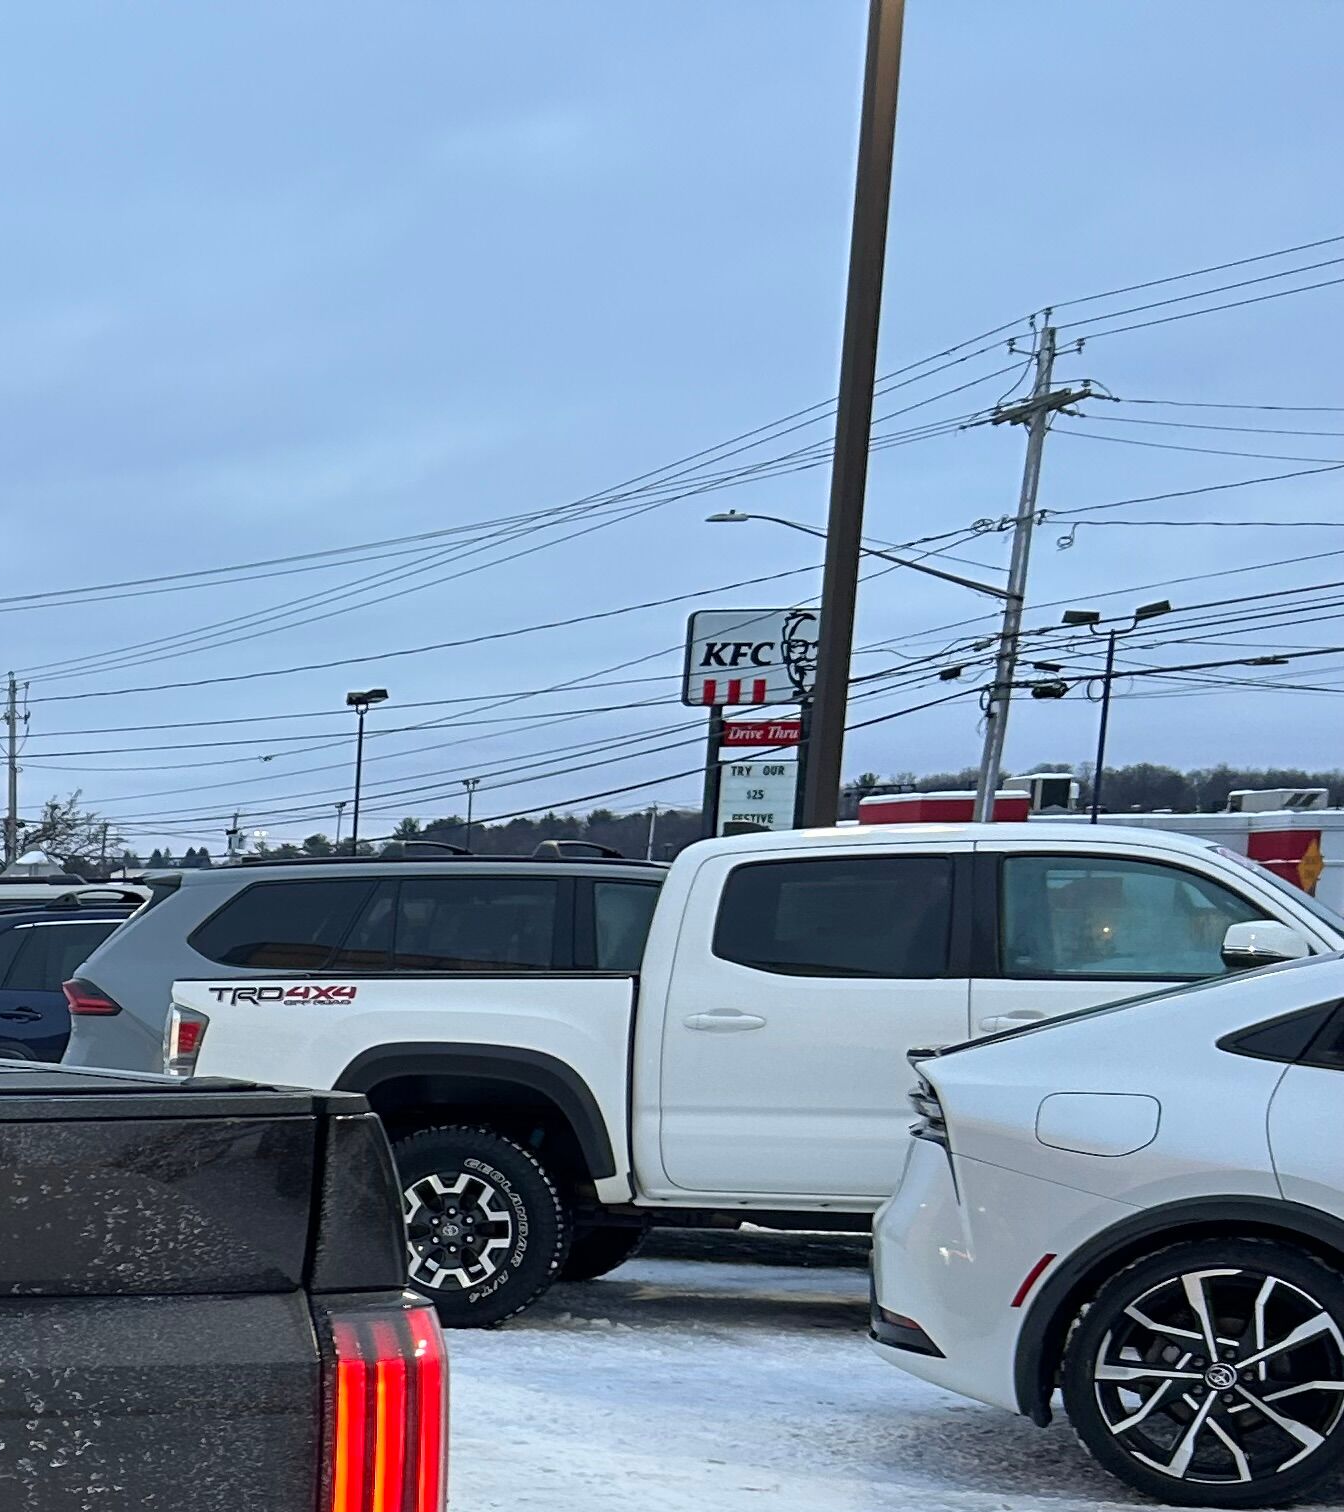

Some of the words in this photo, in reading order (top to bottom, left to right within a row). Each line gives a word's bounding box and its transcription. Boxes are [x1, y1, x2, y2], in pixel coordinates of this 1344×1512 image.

[700, 642, 775, 667] KFC
[727, 726, 764, 740] Drive
[768, 726, 799, 740] Thru
[731, 765, 750, 777] TRY
[763, 765, 785, 776] OUR
[464, 1158, 528, 1267] GEOLANDAR
